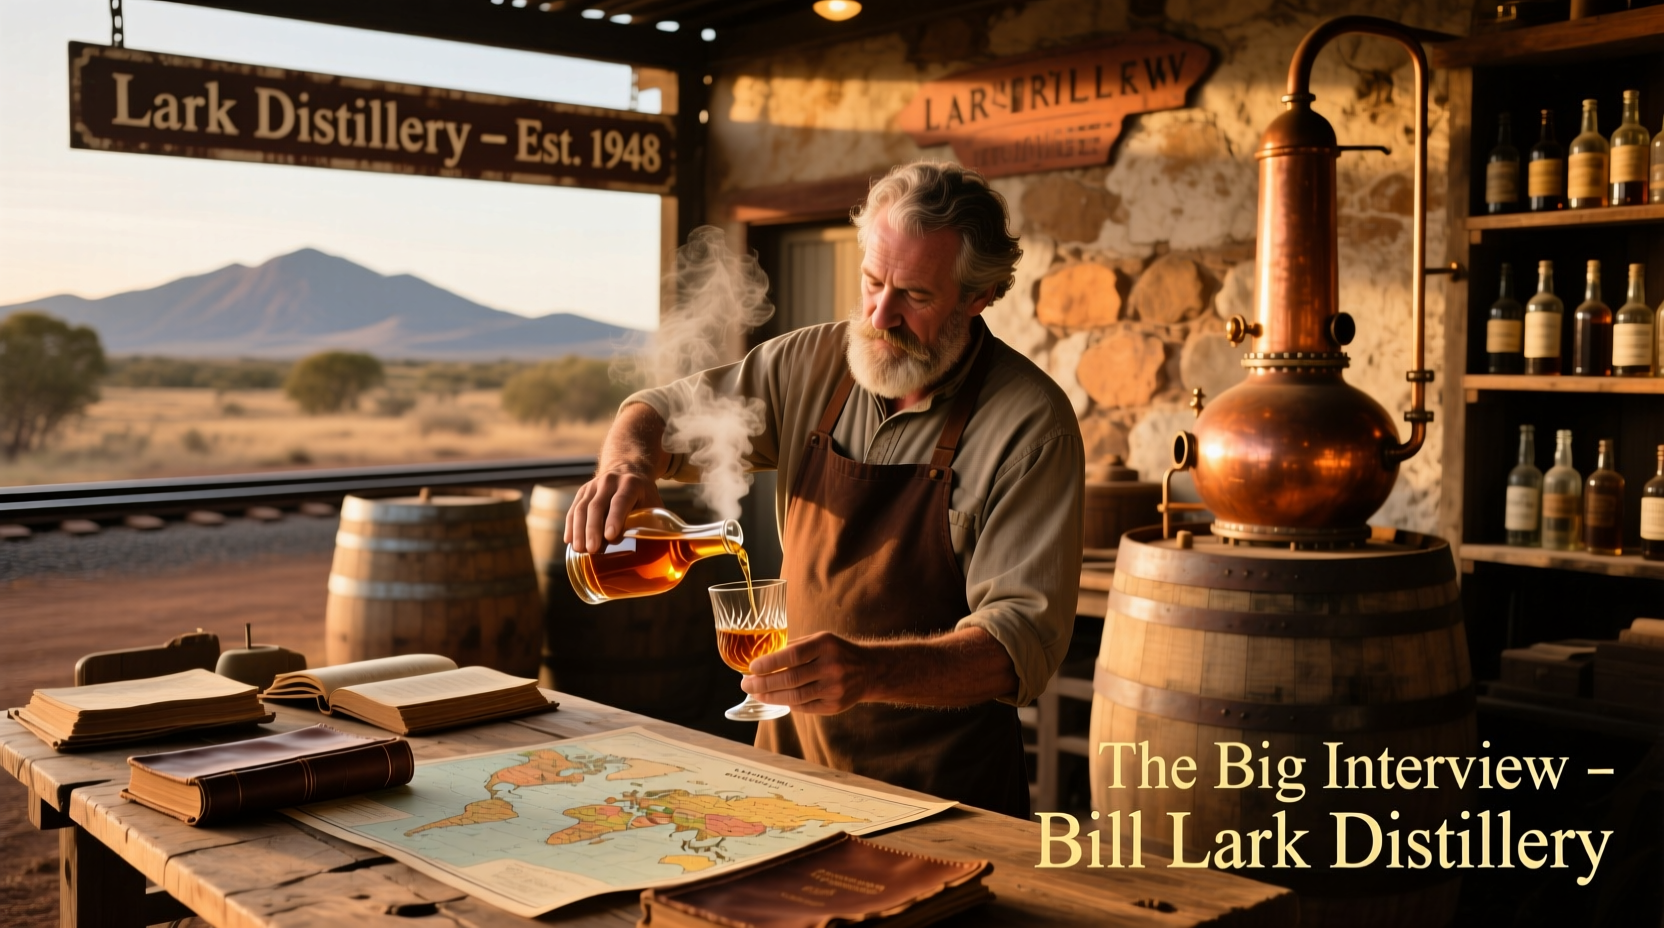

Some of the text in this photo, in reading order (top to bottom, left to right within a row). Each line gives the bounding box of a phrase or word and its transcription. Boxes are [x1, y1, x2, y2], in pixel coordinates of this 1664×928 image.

[111, 72, 239, 136] Lark
[254, 87, 472, 166] Distillery
[515, 118, 582, 166] Est.
[591, 129, 661, 173] 1948
